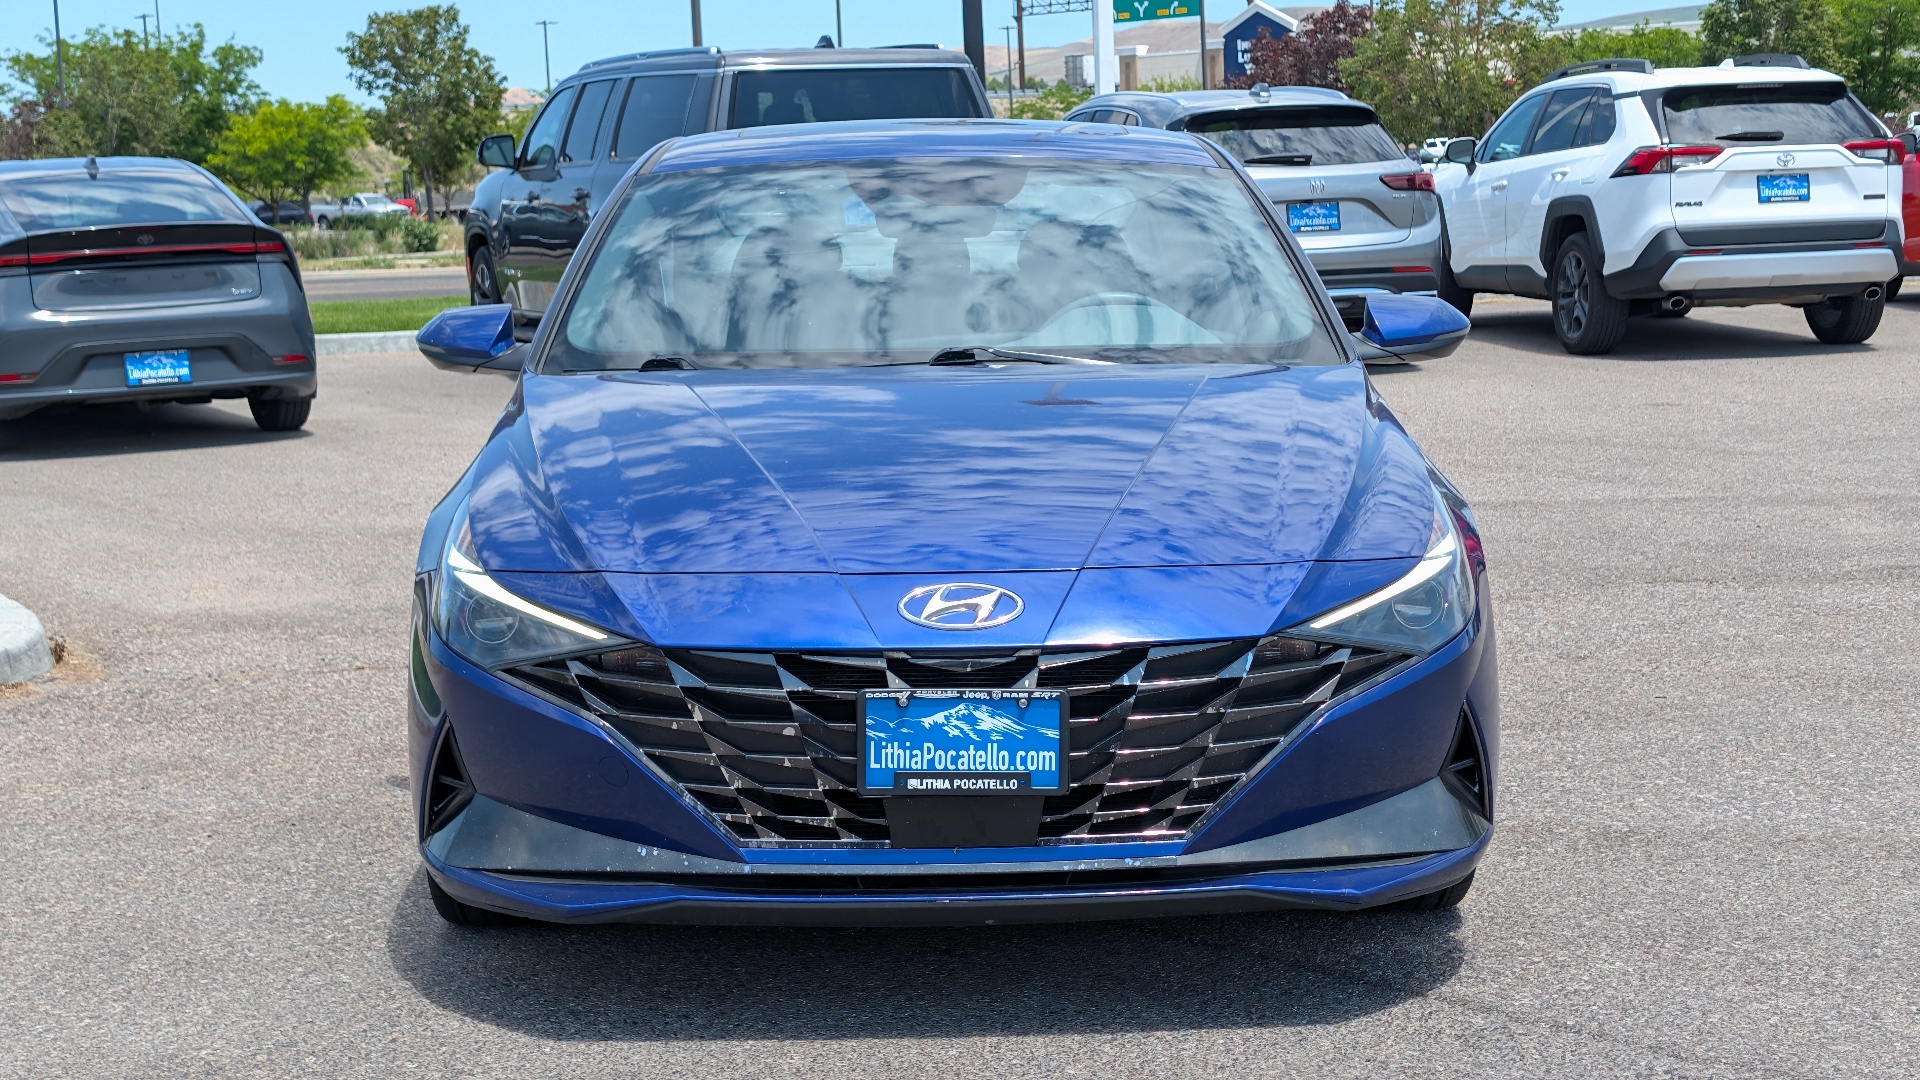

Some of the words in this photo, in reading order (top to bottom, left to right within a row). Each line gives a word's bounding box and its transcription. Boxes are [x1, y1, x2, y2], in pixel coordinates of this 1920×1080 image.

[869, 740, 1056, 772] LithiaPocatello.com
[917, 779, 951, 790] LITHIA
[953, 778, 1018, 790] POCATELLO
